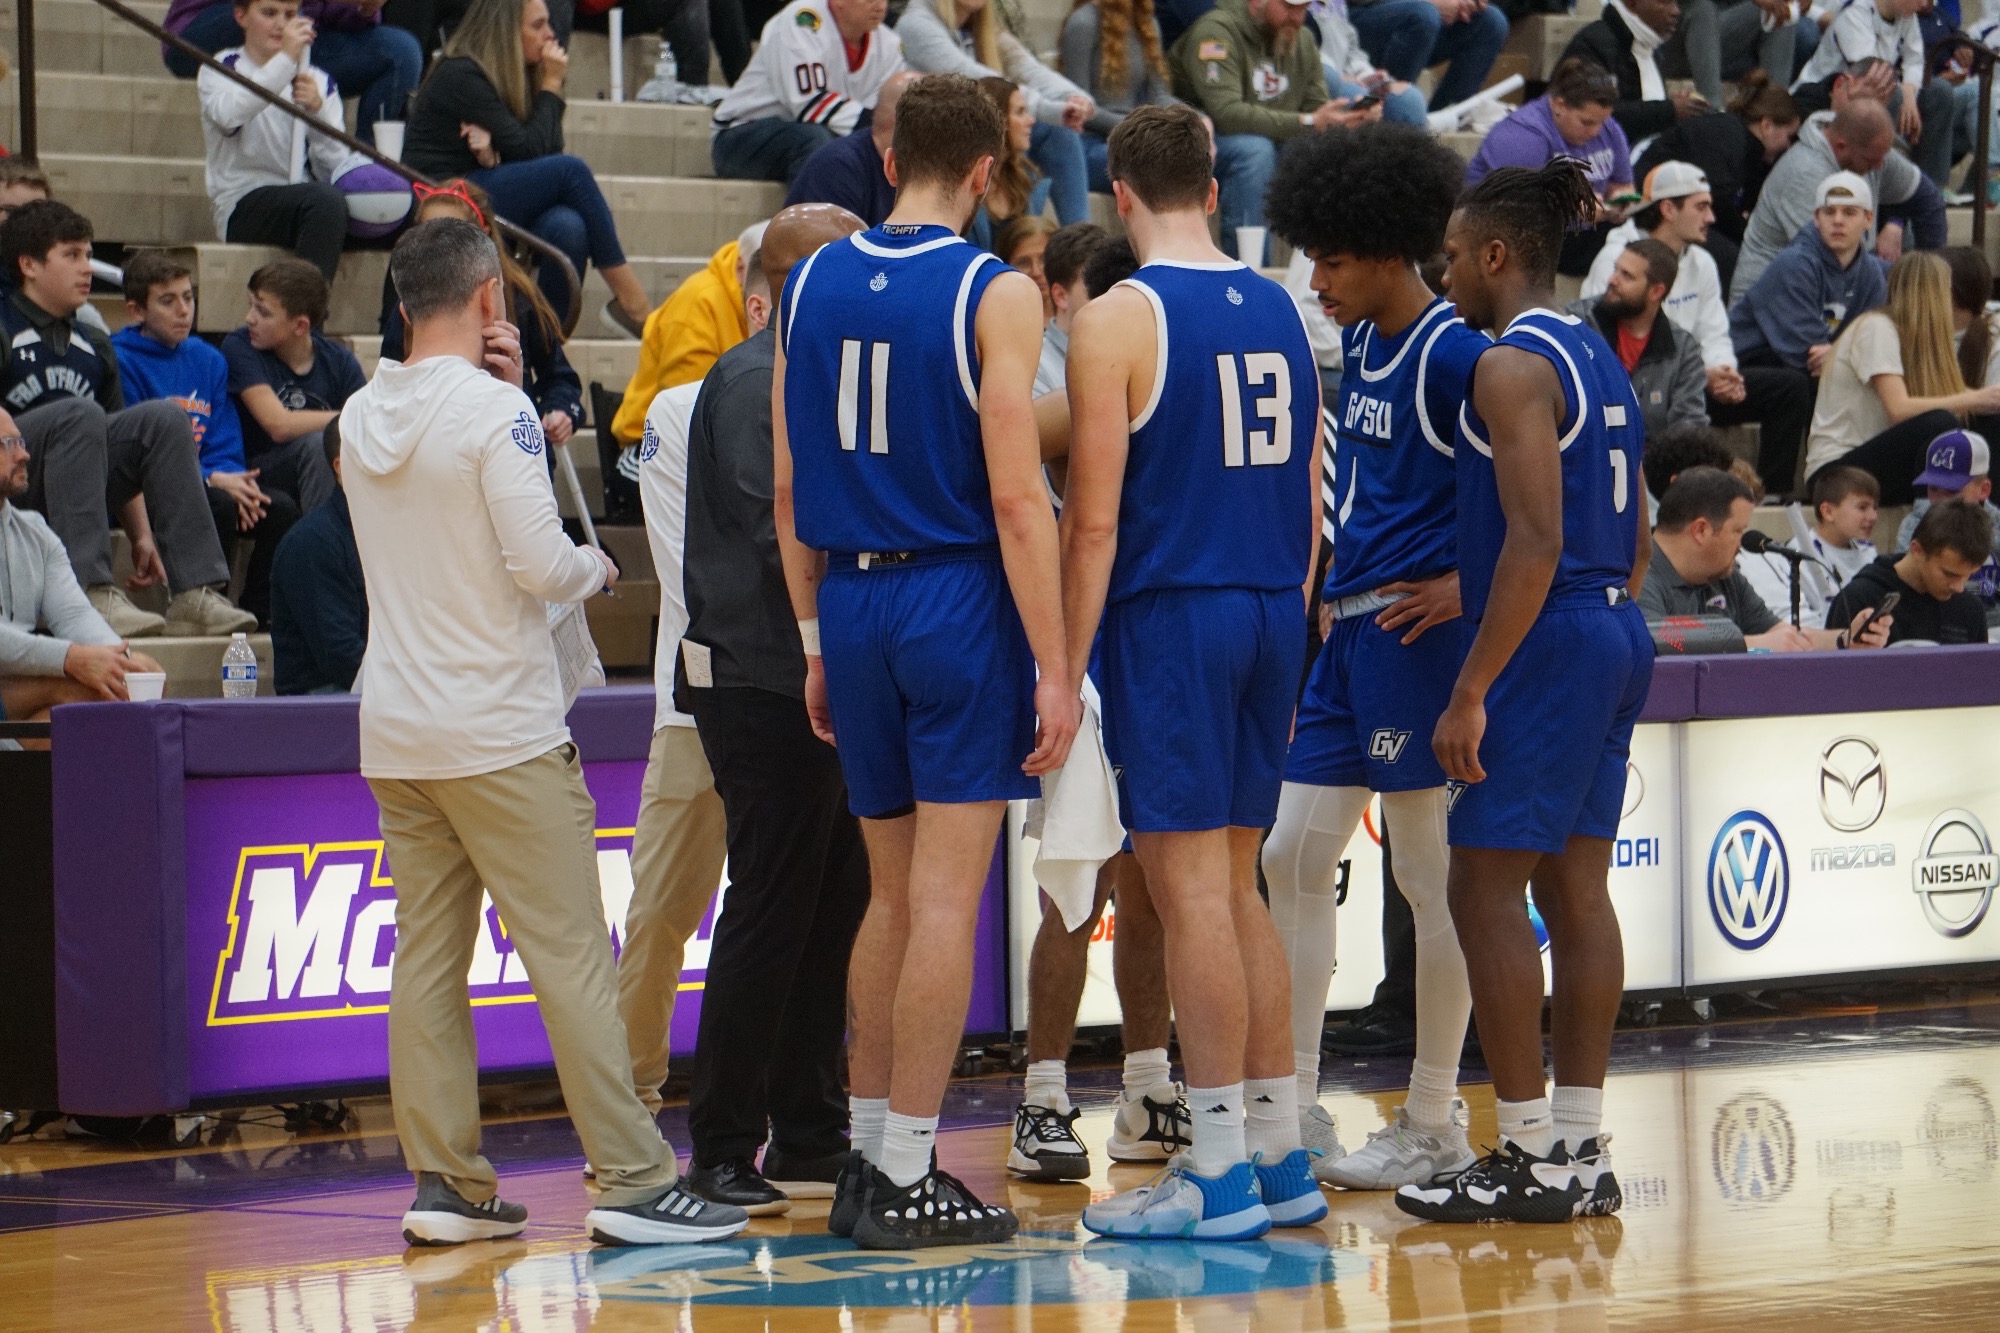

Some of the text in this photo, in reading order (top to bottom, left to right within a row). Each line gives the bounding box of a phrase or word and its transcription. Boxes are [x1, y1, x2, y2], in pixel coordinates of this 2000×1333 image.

[795, 63, 827, 95] 00
[882, 224, 922, 235] TECHFIT
[836, 338, 891, 456] 11
[1215, 351, 1293, 468] 13
[1368, 728, 1413, 764] GV
[1921, 862, 1991, 885] NISSAN
